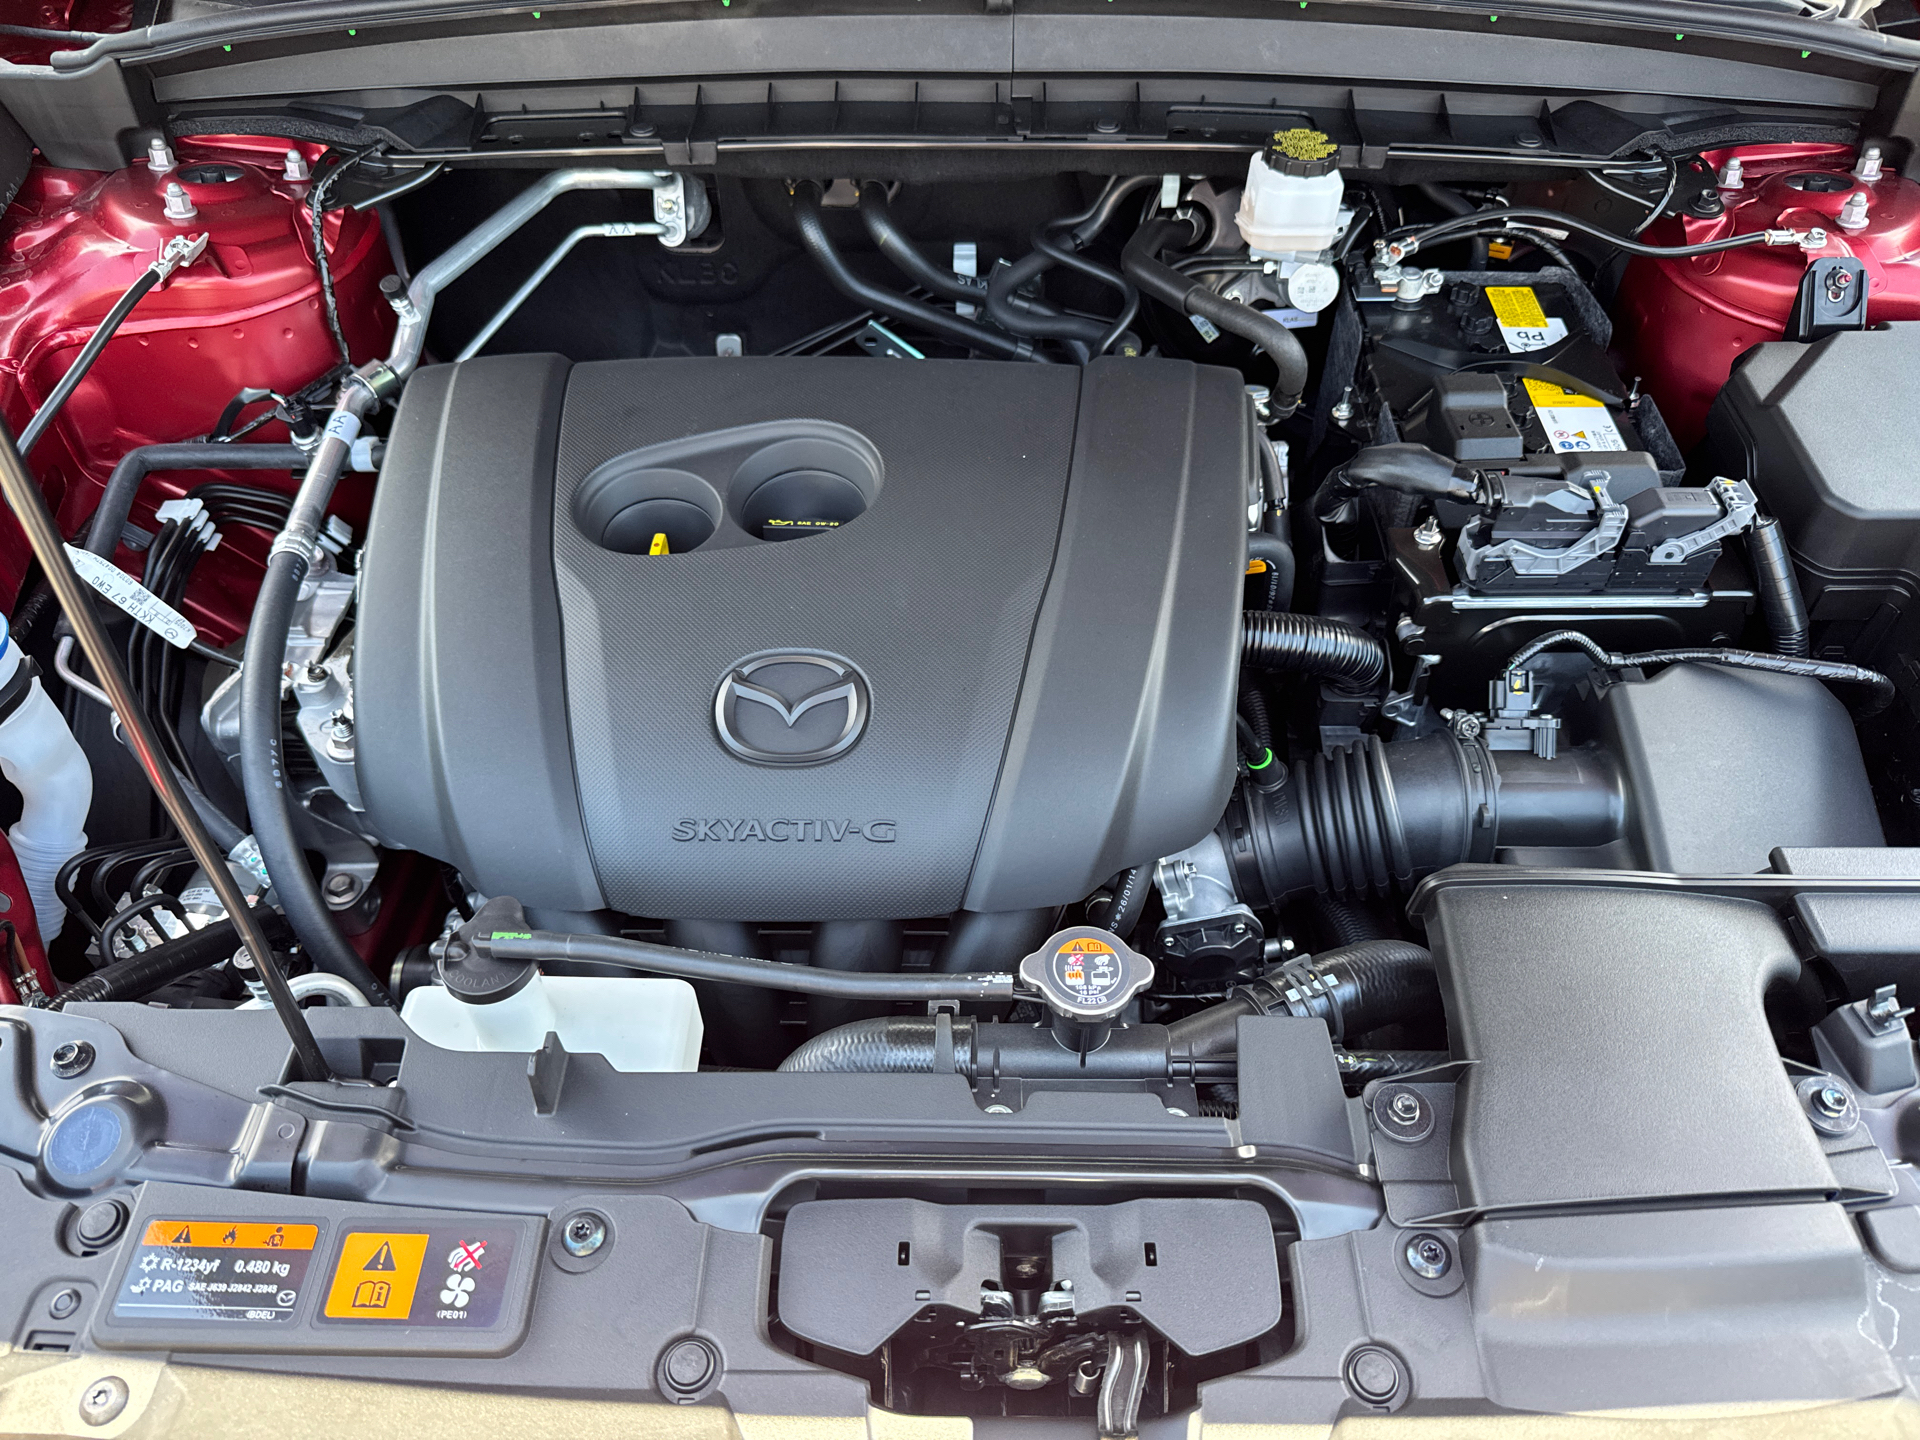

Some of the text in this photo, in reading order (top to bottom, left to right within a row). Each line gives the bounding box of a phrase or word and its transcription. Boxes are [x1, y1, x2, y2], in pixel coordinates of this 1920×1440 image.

[1517, 331, 1545, 341] Pb
[328, 415, 347, 435] AA
[111, 592, 128, 605] 67
[127, 602, 155, 625] KKTH
[672, 818, 897, 843] SKYACTIV-G
[449, 968, 508, 989] COOLANT
[1077, 996, 1097, 1005] FL22
[160, 1258, 290, 1277] R-1234yf 0.480 kg
[152, 1279, 184, 1293] PAG
[188, 1283, 206, 1291] SAE
